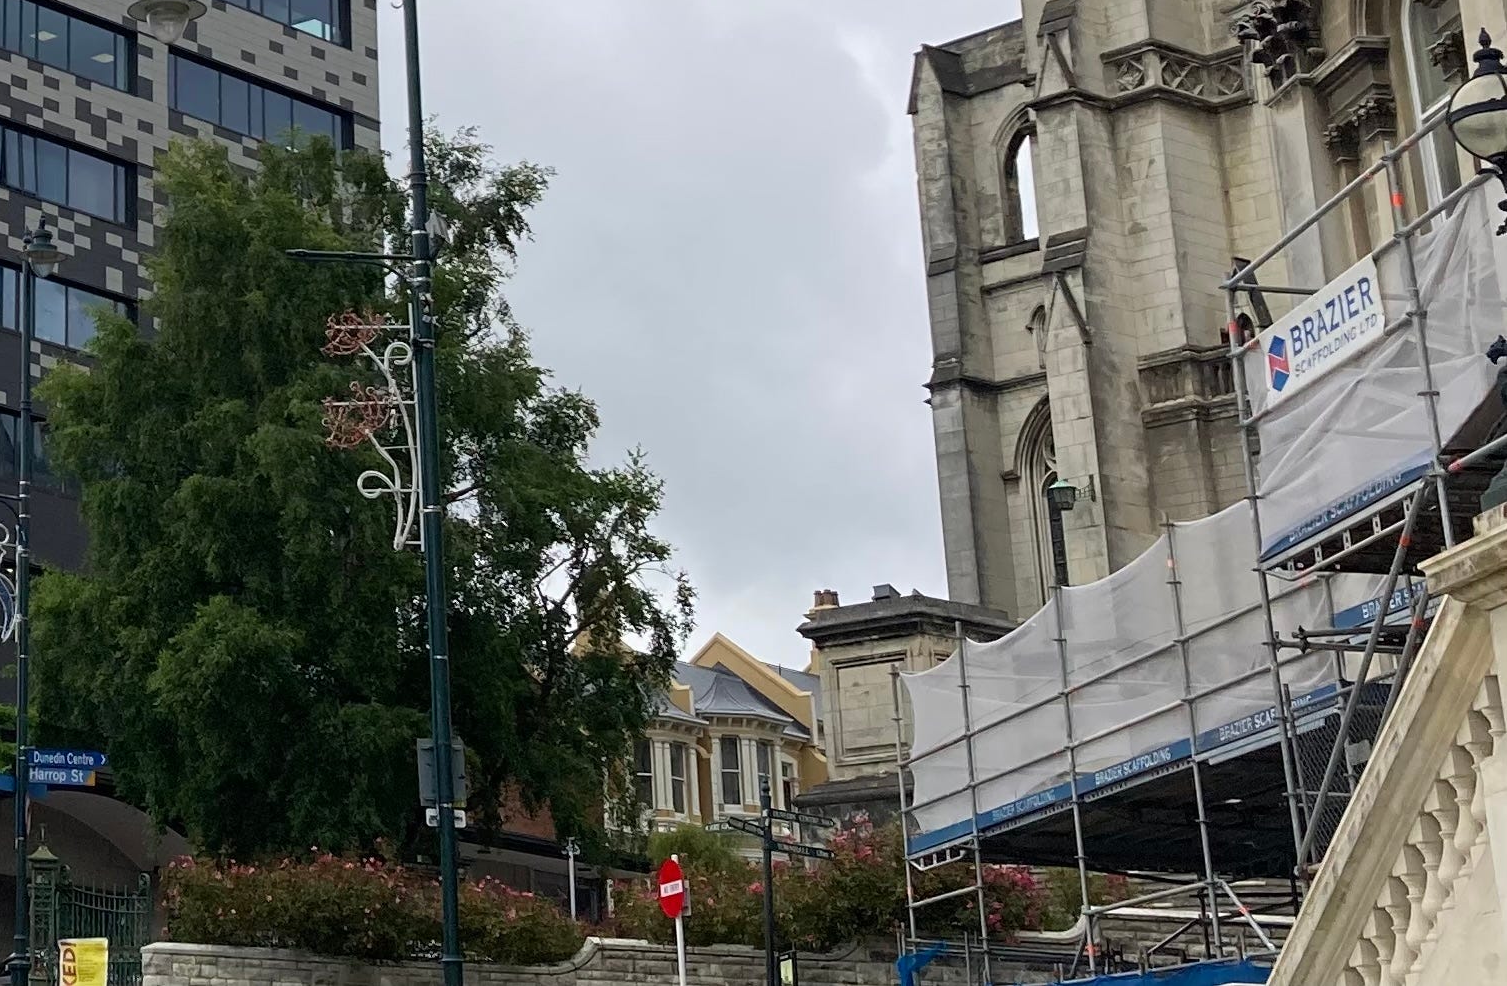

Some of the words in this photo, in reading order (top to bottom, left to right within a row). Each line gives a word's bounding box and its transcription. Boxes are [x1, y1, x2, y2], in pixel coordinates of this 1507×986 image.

[1290, 277, 1374, 357] BRAZIER
[1294, 324, 1358, 378] SCAFFOLDING
[1359, 314, 1378, 338] LTD
[1218, 715, 1254, 742] BRAZIER
[33, 750, 66, 765] Dunedin
[66, 752, 95, 766] Centre
[1123, 747, 1172, 776] SCAFFOLDING
[29, 767, 67, 783] Harrop
[71, 768, 84, 783] St
